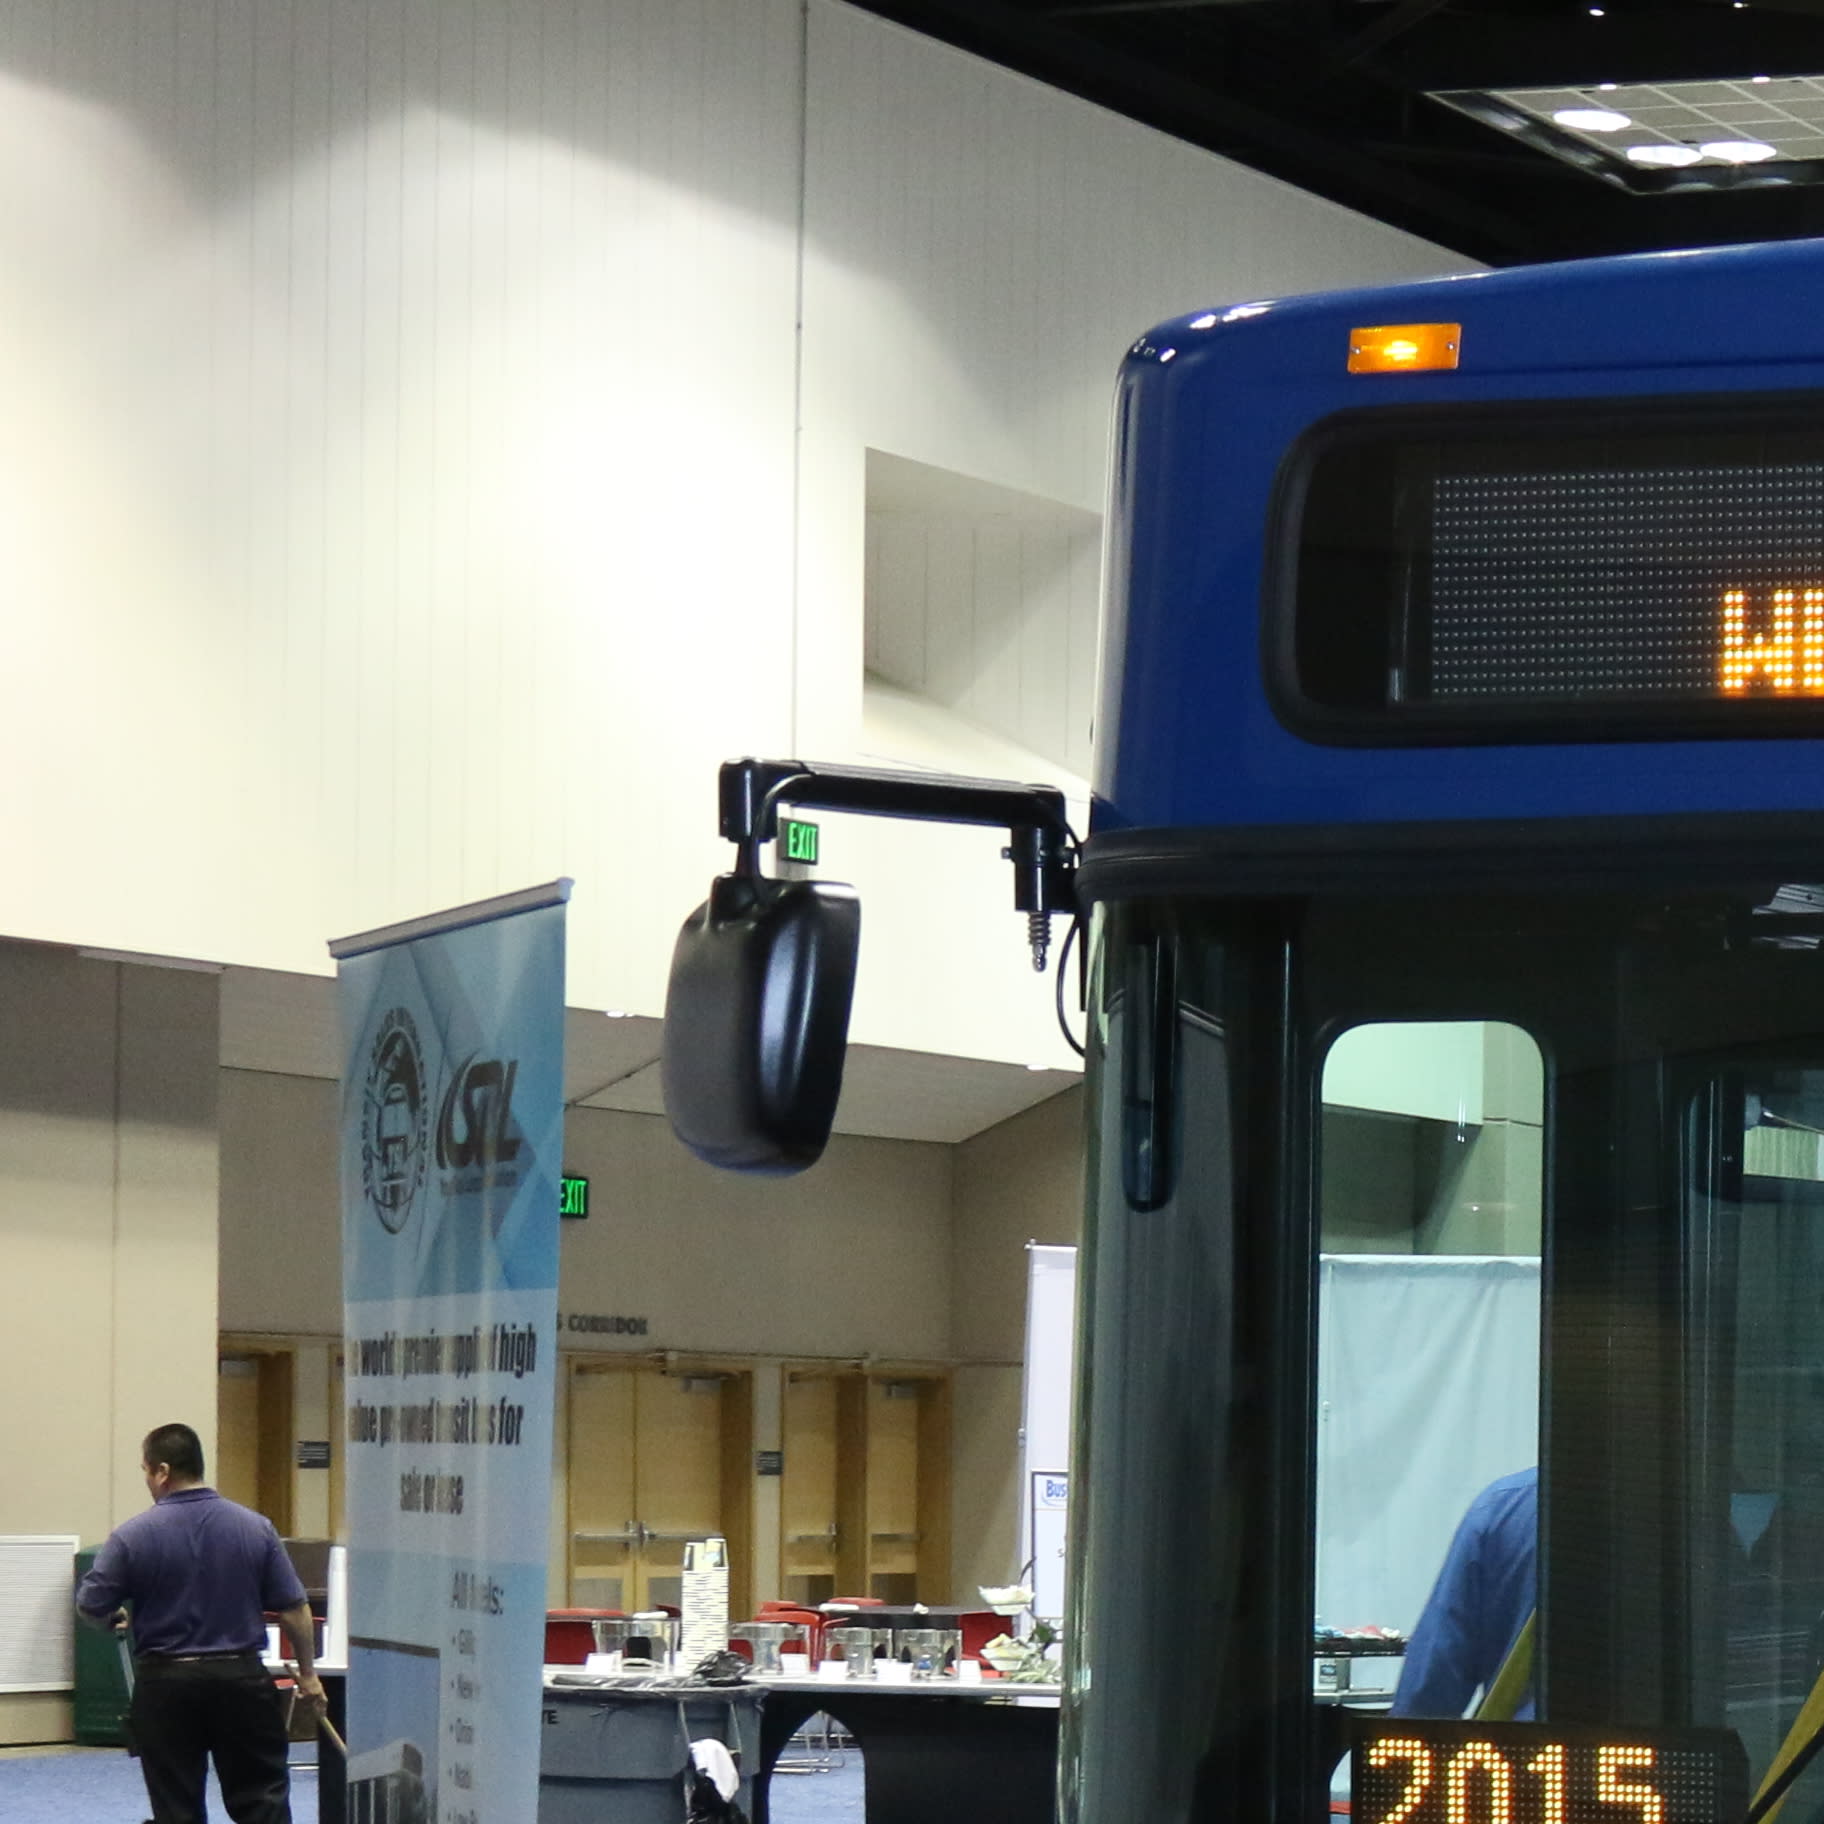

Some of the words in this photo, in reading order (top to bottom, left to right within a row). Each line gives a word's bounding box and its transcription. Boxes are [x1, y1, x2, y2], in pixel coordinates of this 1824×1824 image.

[788, 821, 818, 862] EXIT
[560, 1178, 588, 1215] EXIT
[500, 1322, 537, 1378] high
[498, 1395, 524, 1446] for
